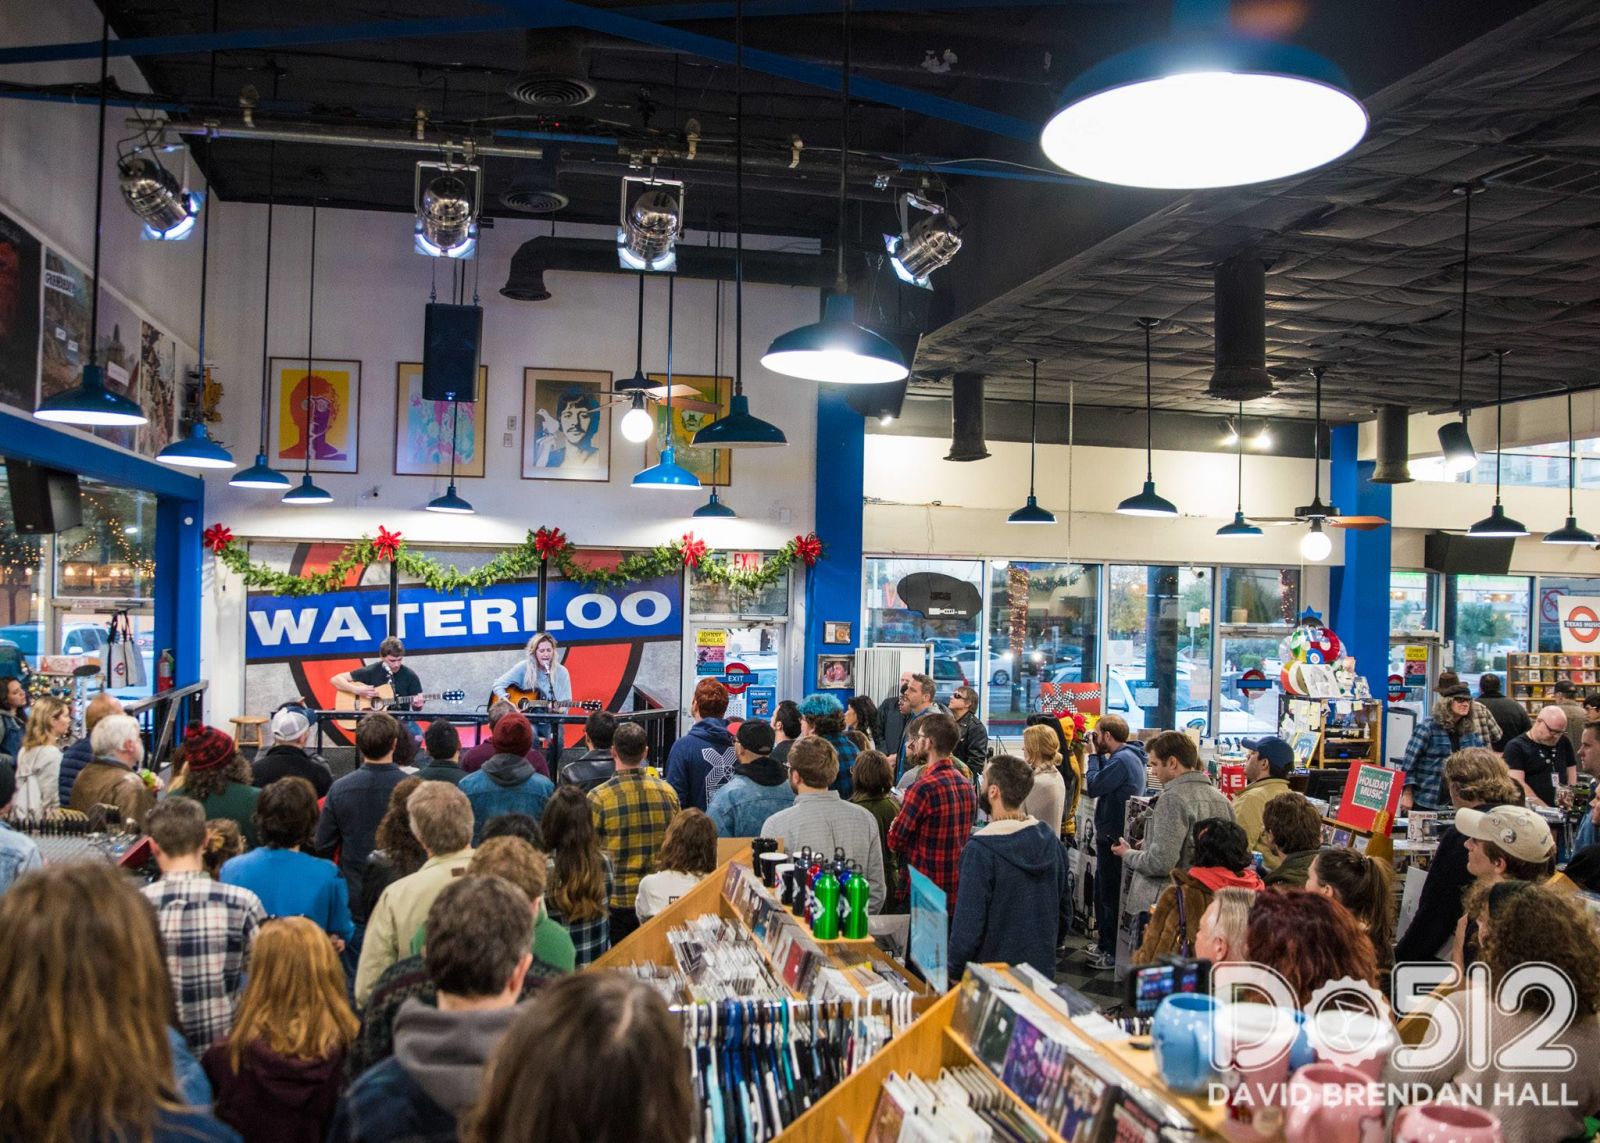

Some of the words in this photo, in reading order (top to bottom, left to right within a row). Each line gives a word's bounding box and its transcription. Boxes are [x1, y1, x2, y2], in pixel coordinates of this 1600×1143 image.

[734, 553, 760, 571] EXIT
[248, 590, 672, 646] WATERLOO
[1359, 776, 1389, 790] HOLIDAY
[1360, 787, 1384, 800] MUSIC
